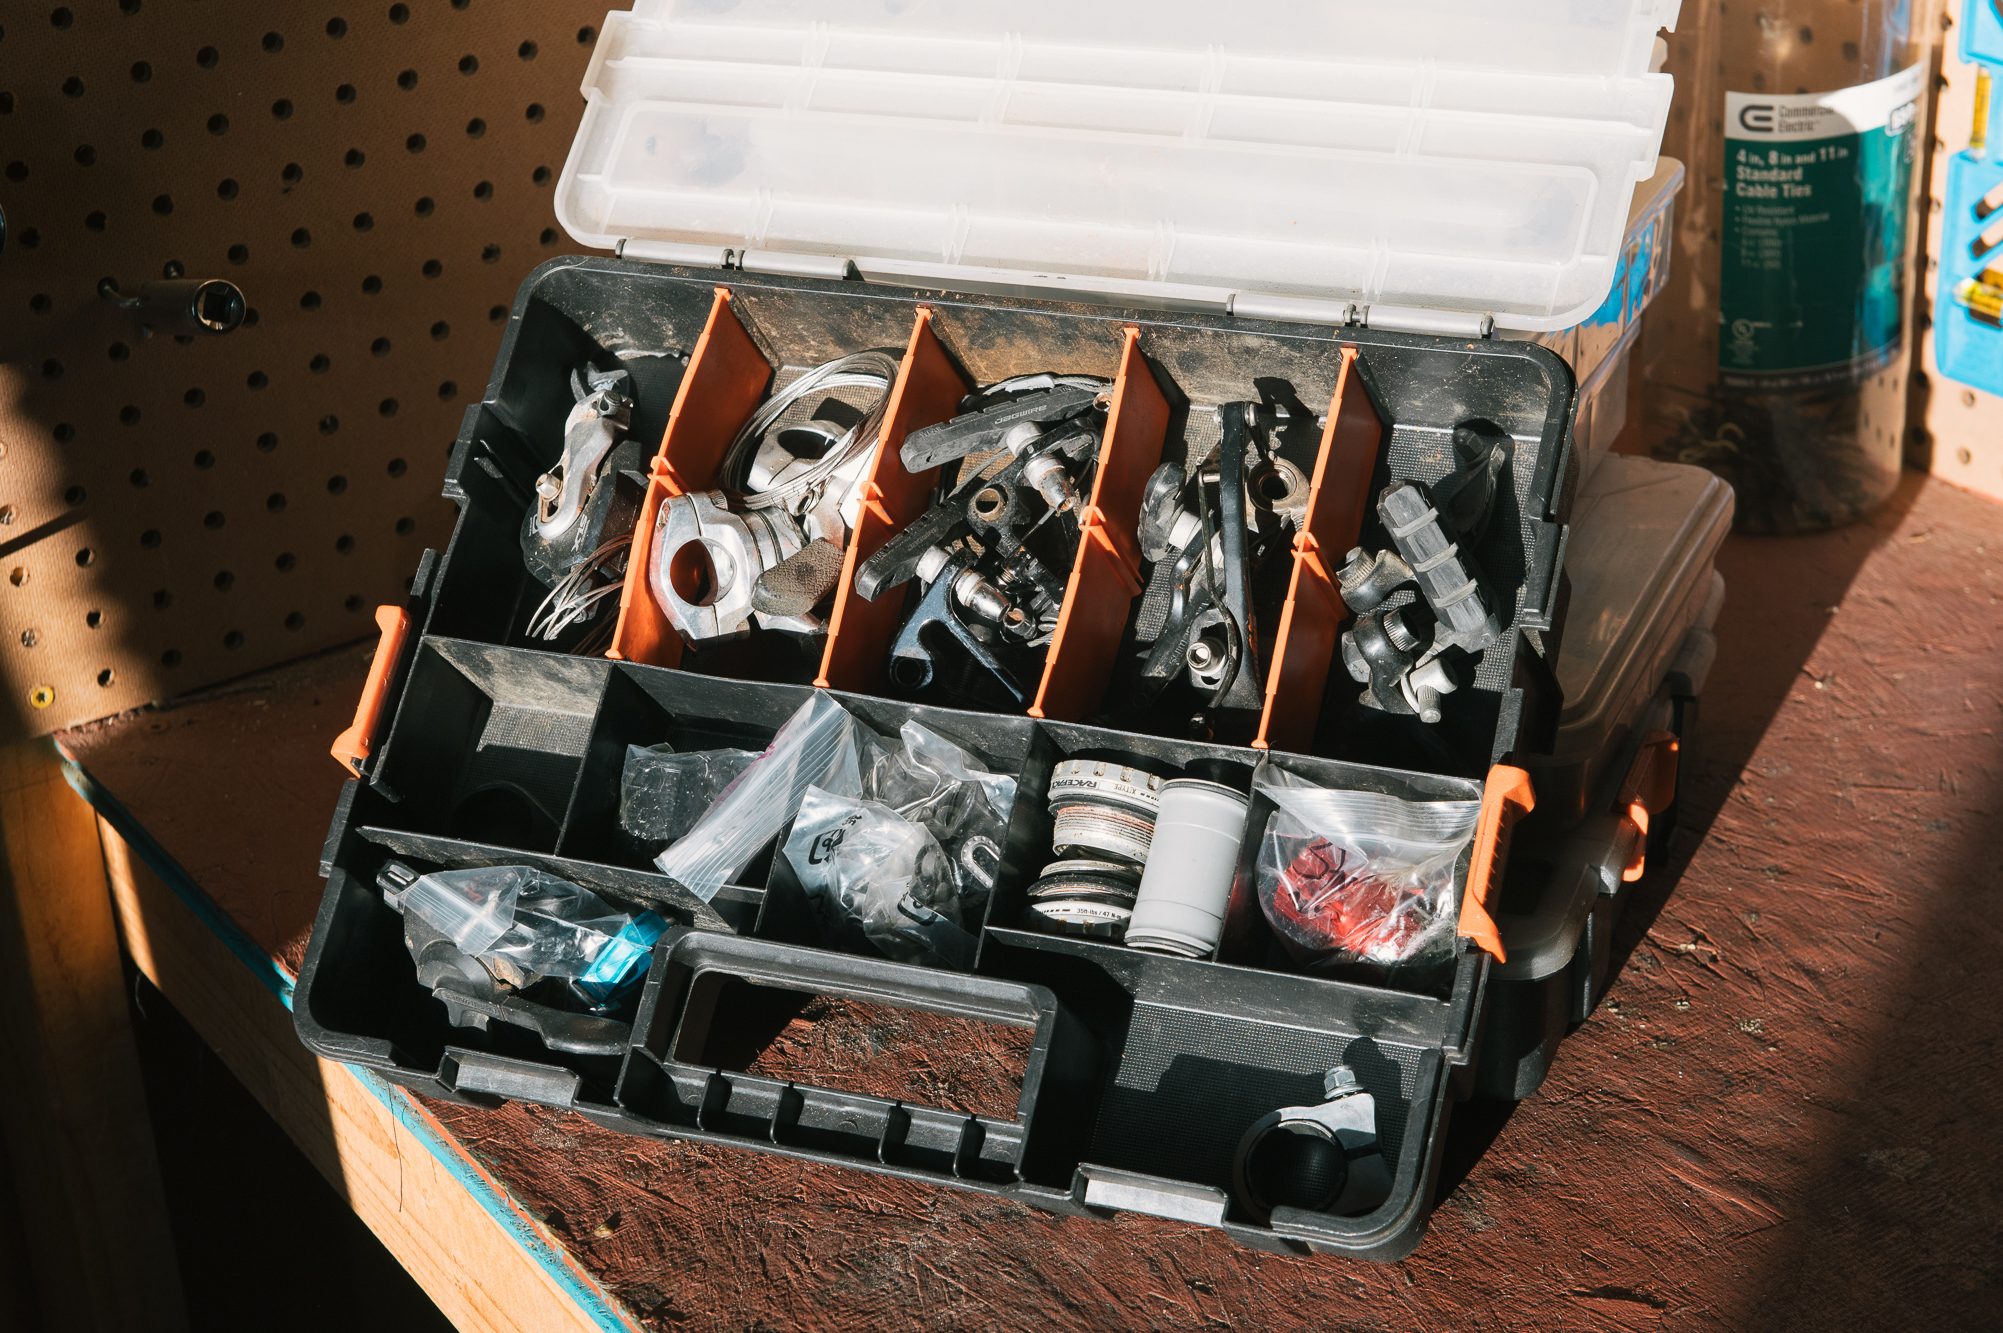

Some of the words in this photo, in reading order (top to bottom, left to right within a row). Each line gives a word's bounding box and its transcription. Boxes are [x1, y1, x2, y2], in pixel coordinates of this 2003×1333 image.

[1737, 149, 1747, 163] 4
[1768, 150, 1779, 165] 8
[1781, 153, 1793, 165] in
[1795, 151, 1816, 165] and
[1818, 145, 1836, 162] 11
[1736, 164, 1803, 182] Standard
[1736, 181, 1778, 199] Cable
[1782, 183, 1812, 198] Ties
